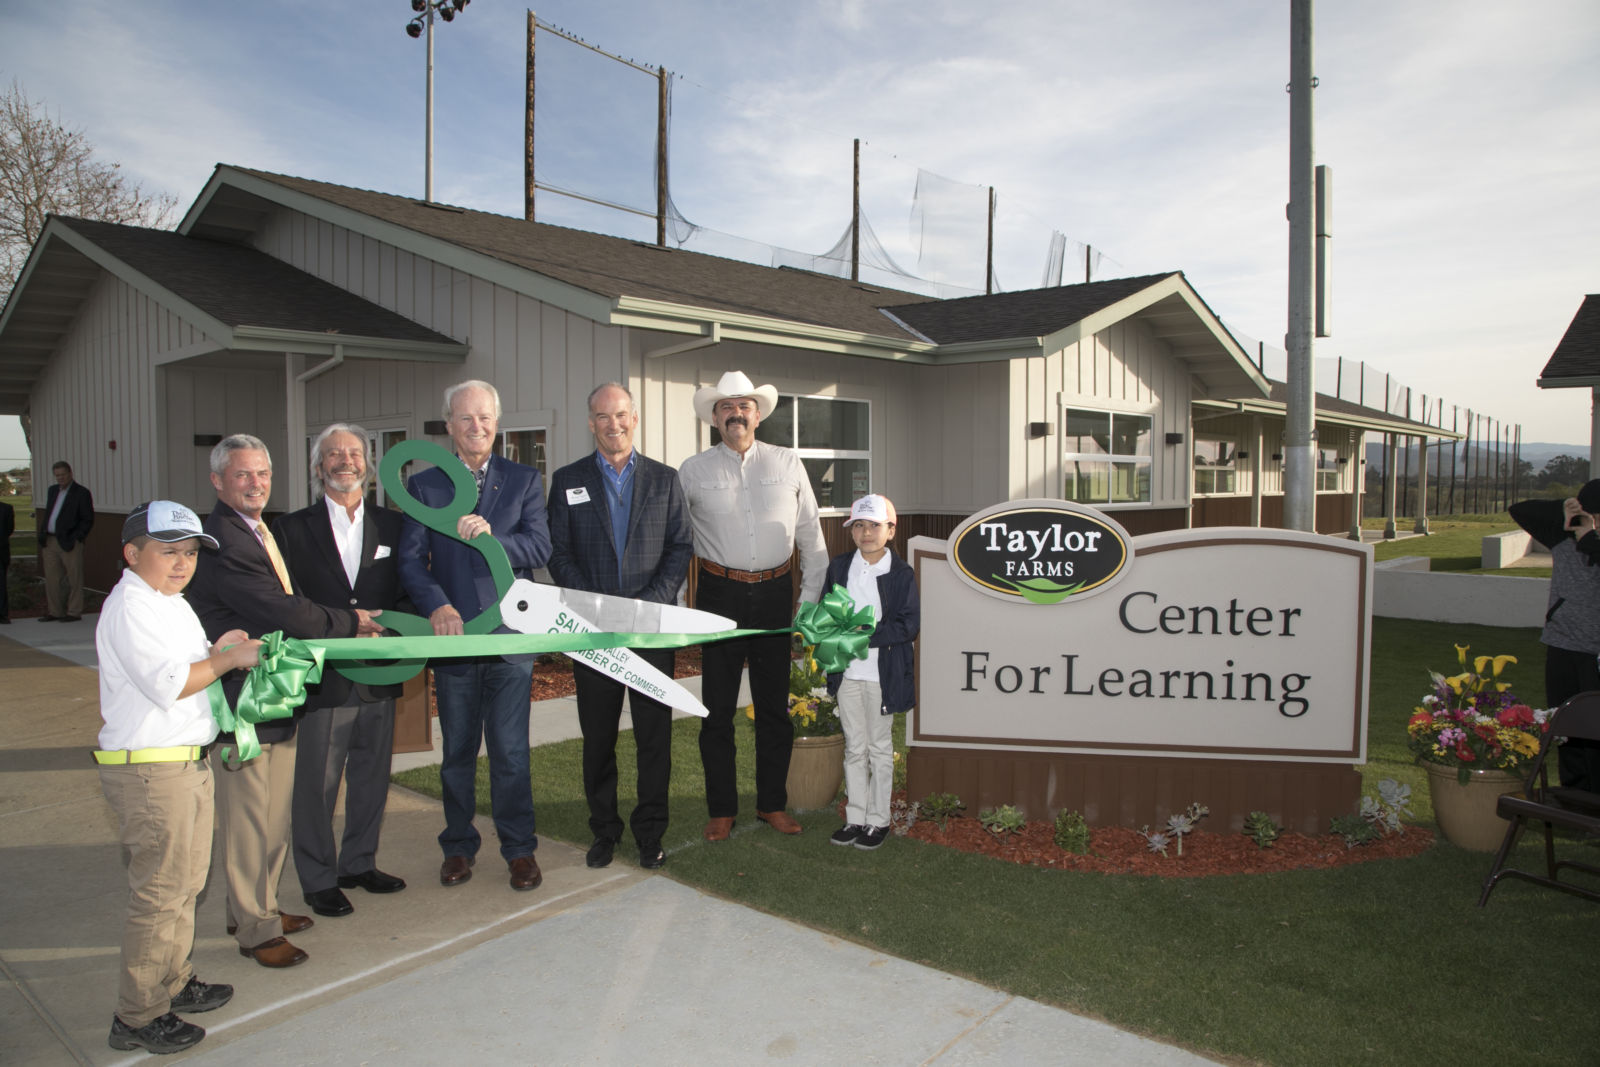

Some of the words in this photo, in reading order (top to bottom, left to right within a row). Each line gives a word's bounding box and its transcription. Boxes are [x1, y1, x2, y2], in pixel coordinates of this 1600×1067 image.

[980, 523, 1102, 561] Taylor
[1005, 561, 1074, 577] FARMS
[1118, 591, 1302, 637] Center
[610, 663, 624, 675] OF
[624, 671, 667, 699] COMMERCE
[960, 651, 1051, 694] For
[1061, 654, 1312, 718] Learning
